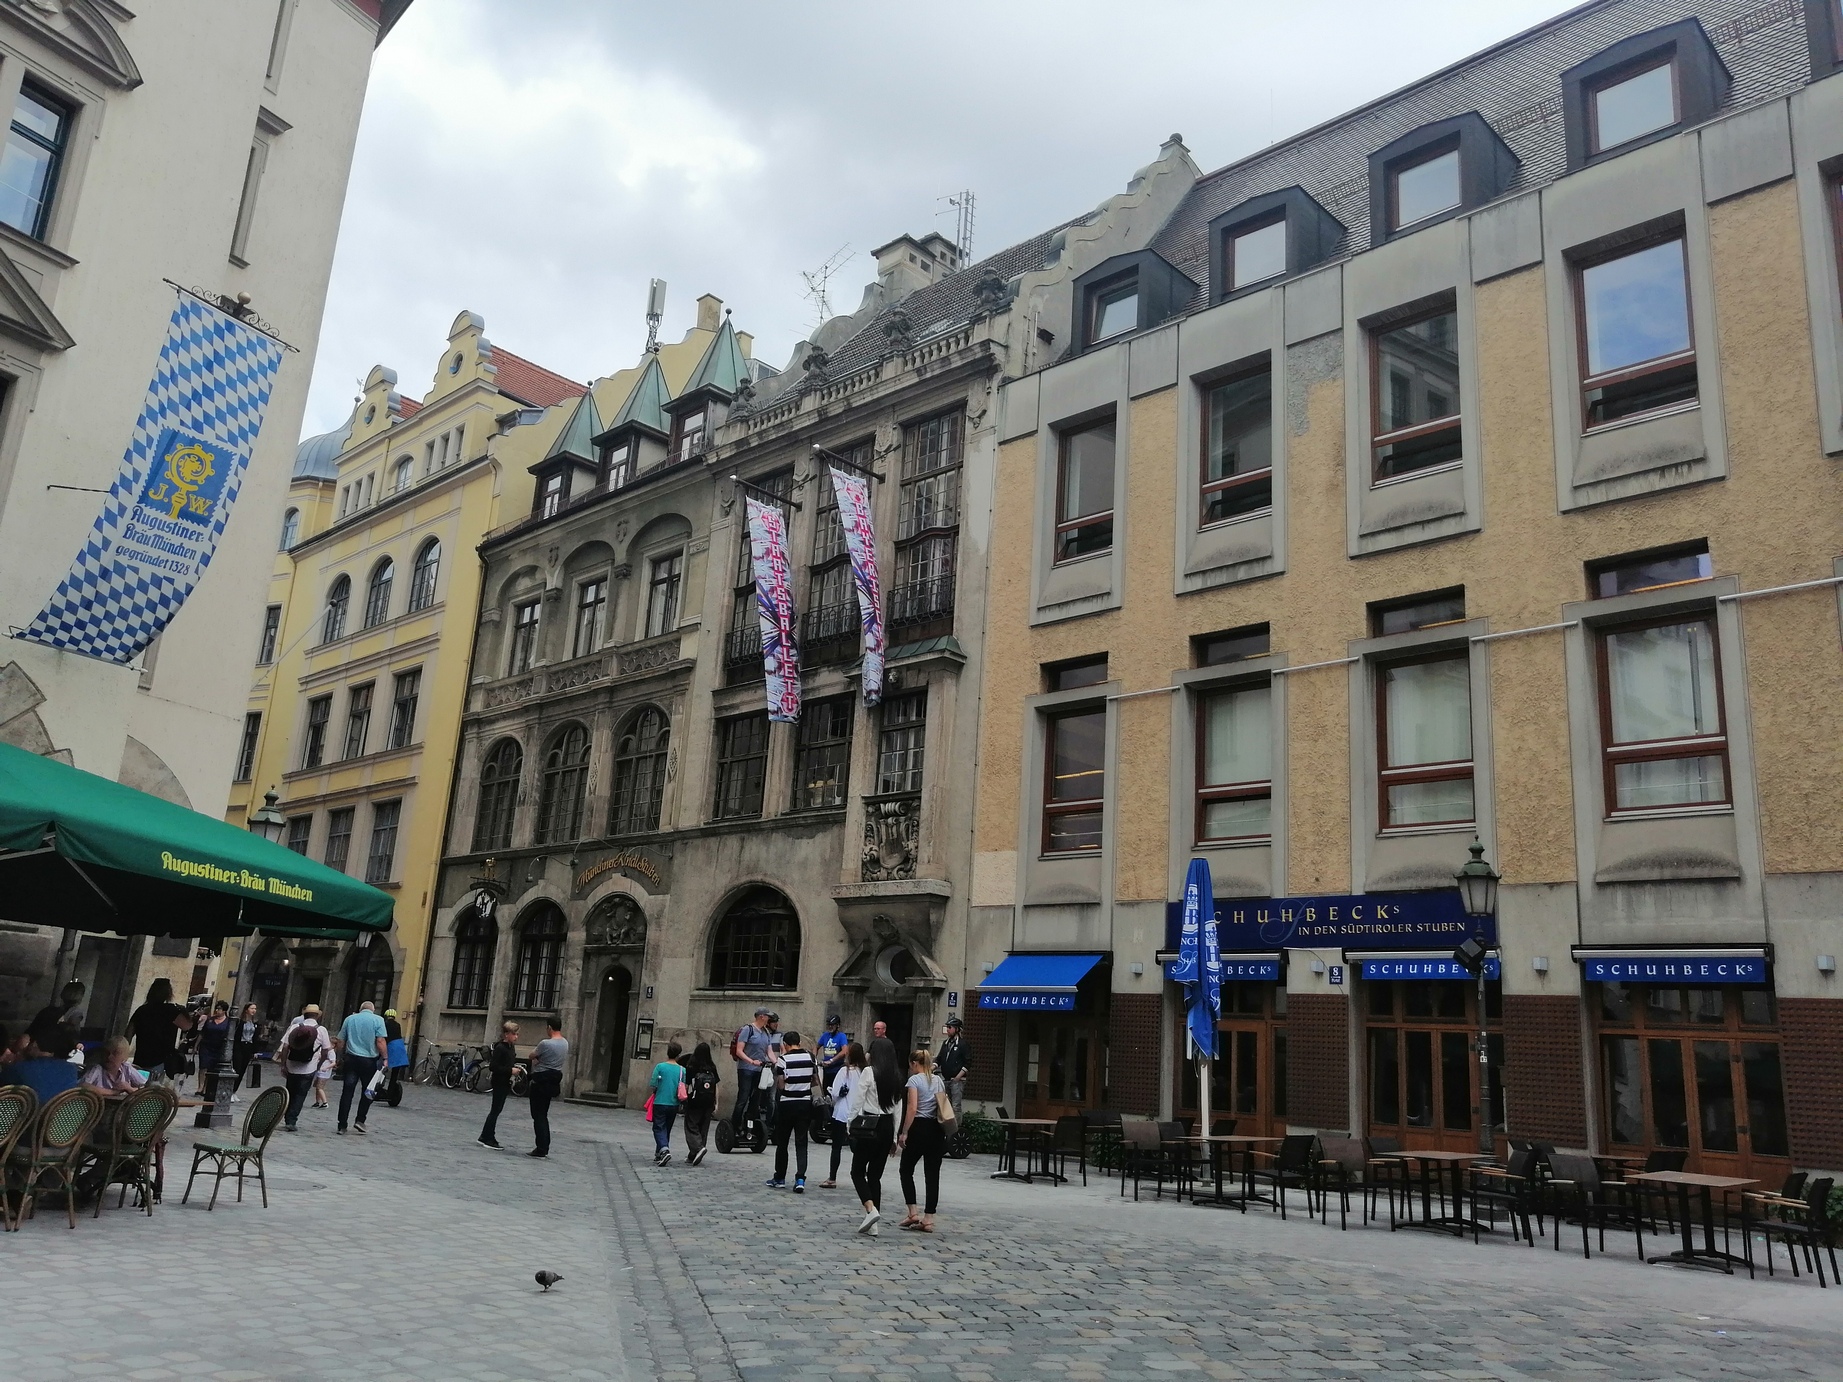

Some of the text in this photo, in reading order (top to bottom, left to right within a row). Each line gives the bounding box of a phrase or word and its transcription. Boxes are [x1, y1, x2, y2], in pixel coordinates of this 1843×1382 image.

[148, 483, 213, 516] J. W.
[122, 523, 197, 560] Bräu München
[115, 545, 191, 576] gegründet 1328
[768, 515, 795, 711] STAATSBALLETT
[268, 877, 313, 902] München
[1210, 905, 1400, 924] CHUHBECKs
[1298, 922, 1466, 935] IN DEN SÜDTIROLER STUBEN
[1332, 966, 1339, 976] 8
